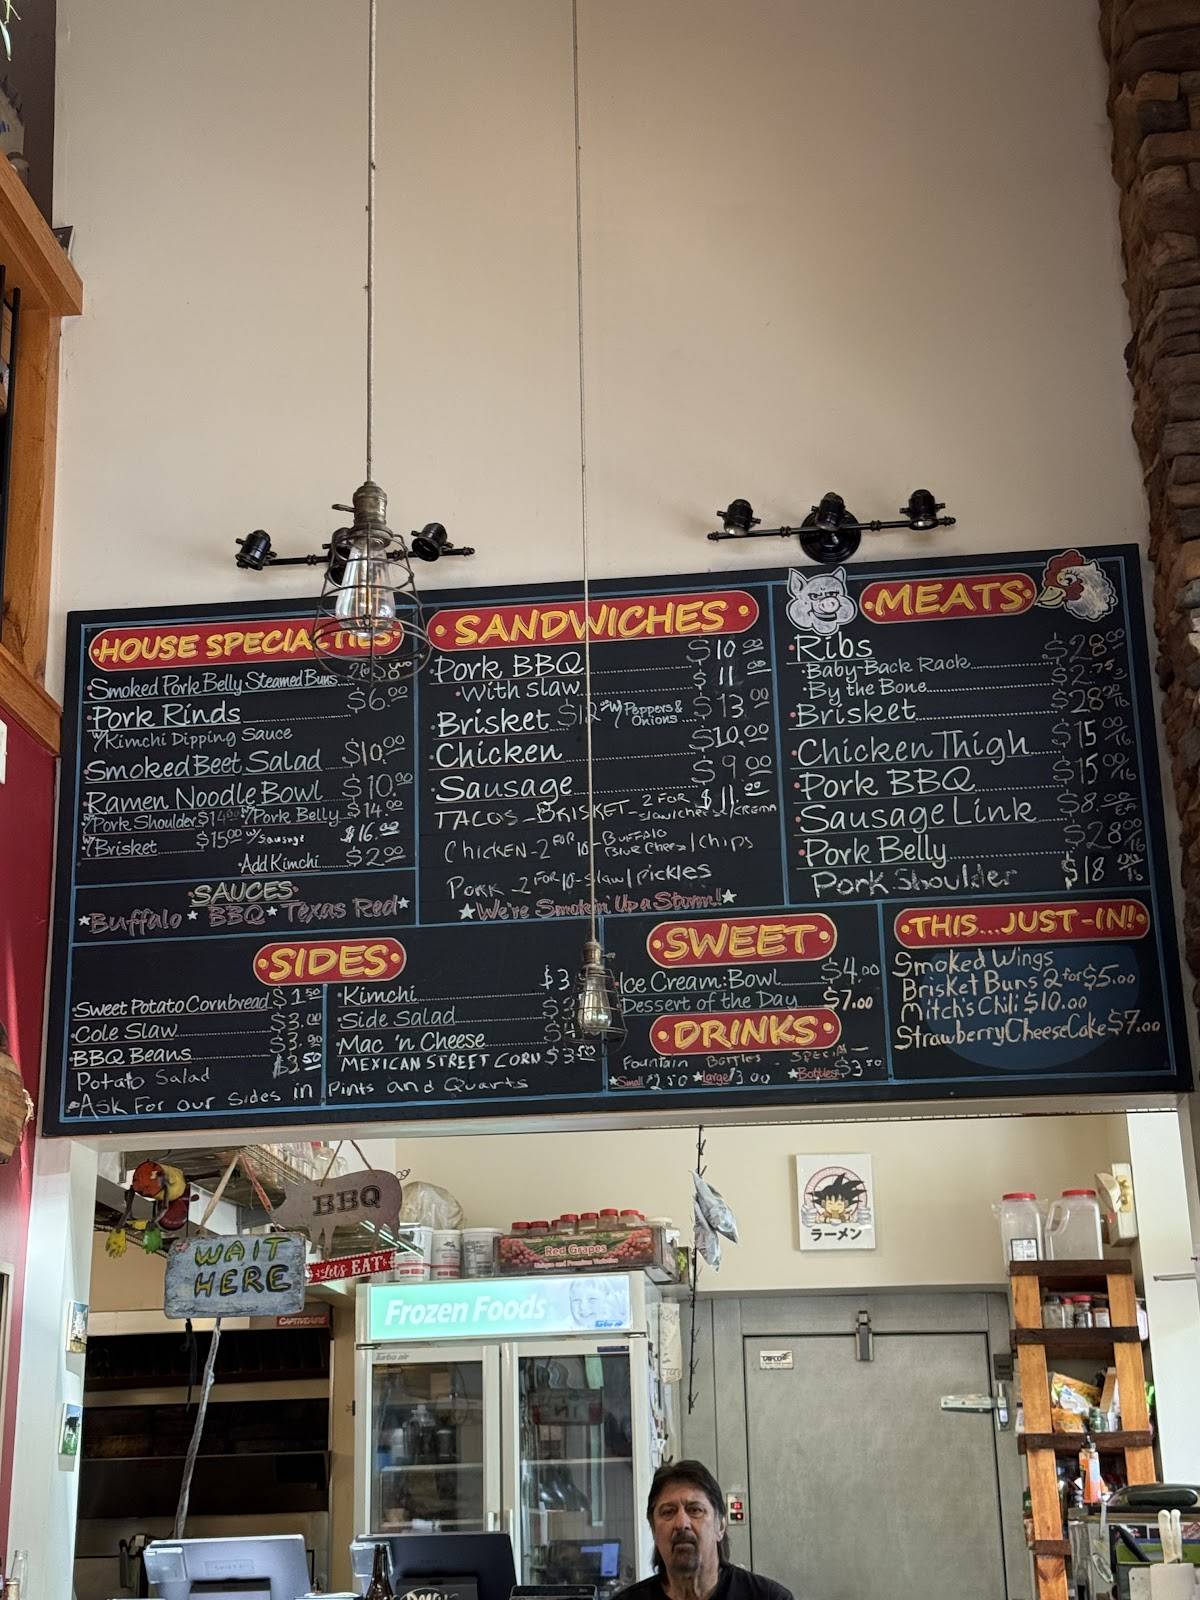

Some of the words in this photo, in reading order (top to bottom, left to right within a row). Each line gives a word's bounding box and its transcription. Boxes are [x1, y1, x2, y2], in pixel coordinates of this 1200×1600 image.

[874, 580, 1024, 616] MEATS
[454, 600, 728, 645] SANDWICHES
[99, 633, 199, 663] HOUSE
[794, 630, 874, 662] Ribs
[434, 655, 504, 683] Pork
[512, 651, 585, 678] BBQ
[918, 653, 972, 673] Rack
[90, 675, 159, 700] Smoked
[163, 673, 200, 696] Pork
[202, 672, 243, 696] Belly
[246, 669, 304, 690] Steamed
[304, 668, 338, 687] Buns
[526, 677, 581, 698] slaw
[808, 680, 841, 706] By
[846, 676, 876, 696] the
[879, 677, 929, 696] Bone
[92, 704, 155, 730] Pork
[162, 700, 241, 727] Rinds
[436, 707, 551, 736] Brisket
[624, 701, 673, 719] Peppers
[631, 714, 679, 727] Onions
[794, 698, 917, 729] Brisket
[171, 730, 236, 750] Dipping
[241, 727, 294, 743] Sauce
[436, 739, 563, 767] Chicken
[797, 736, 933, 766] Chicken
[931, 729, 1031, 766] Thigh
[86, 754, 190, 782] Smoked
[193, 754, 243, 777] Beet
[246, 749, 322, 773] Salad
[86, 790, 170, 815] Ramen
[176, 782, 256, 808] Noodle
[260, 780, 324, 805] Bowl
[435, 775, 573, 805] Sausage
[799, 769, 879, 800] Pork
[887, 765, 976, 795] BBQ
[133, 813, 197, 831] Shoulder
[296, 806, 340, 828] Belly
[434, 809, 519, 831] TACOS
[800, 801, 945, 834] Sausage
[953, 796, 1037, 825] Link
[240, 853, 269, 875] Add
[270, 852, 320, 873] Kimchi
[804, 837, 870, 868] Pork
[877, 833, 947, 869] Belly
[192, 880, 295, 905] SAUCES
[811, 868, 889, 898] Pork
[88, 910, 182, 938] Buffalo
[207, 904, 267, 927] BBQ
[281, 900, 347, 925] Texas
[352, 895, 400, 919] Red
[474, 899, 530, 921] We're
[614, 893, 640, 913] Up
[663, 922, 818, 960] SWEET
[268, 943, 388, 982] SIDES
[891, 947, 986, 977] Smoked
[991, 945, 1055, 970] Wings
[342, 984, 418, 1007] Kimchi
[620, 971, 647, 995] Ice
[728, 968, 782, 989] Bowl
[902, 974, 979, 1002] Brisket
[984, 969, 1038, 996] Buns
[1043, 968, 1063, 989] 2
[1062, 967, 1082, 983] for
[74, 1001, 128, 1019] Sweet
[131, 998, 185, 1016] Potato
[186, 992, 271, 1014] Cornbread
[620, 995, 692, 1015] Dessert
[696, 991, 720, 1013] of
[720, 991, 752, 1010] the
[756, 990, 799, 1011] Day
[901, 996, 975, 1023] Mitch's
[977, 993, 1018, 1016] Chili
[74, 1024, 119, 1043] Cole
[124, 1022, 178, 1040] Slaw
[340, 1011, 389, 1031] Side
[393, 1005, 456, 1026] Salad
[673, 1013, 819, 1049] DRINKS
[73, 1049, 125, 1067] BBQ
[130, 1047, 193, 1065] Beans
[338, 1035, 385, 1055] Mac
[420, 1031, 486, 1051] Cheese
[340, 1056, 422, 1073] MEXICAN
[426, 1053, 491, 1070] STREET
[494, 1051, 542, 1069] CORN
[76, 1071, 145, 1092] Potato
[156, 1067, 211, 1085] Salad
[79, 1093, 128, 1120] Ask
[386, 1078, 435, 1094] and
[444, 1076, 529, 1092] Quarts
[311, 1183, 382, 1218] BBQ
[811, 1227, 862, 1242] ラーメン
[193, 1236, 292, 1268] WAIT
[351, 1255, 384, 1276] EAT
[544, 1245, 567, 1257] Red
[567, 1244, 608, 1257] Grapes
[193, 1263, 292, 1300] HERE
[384, 1298, 469, 1327] Frozen
[472, 1293, 548, 1322] Foods
